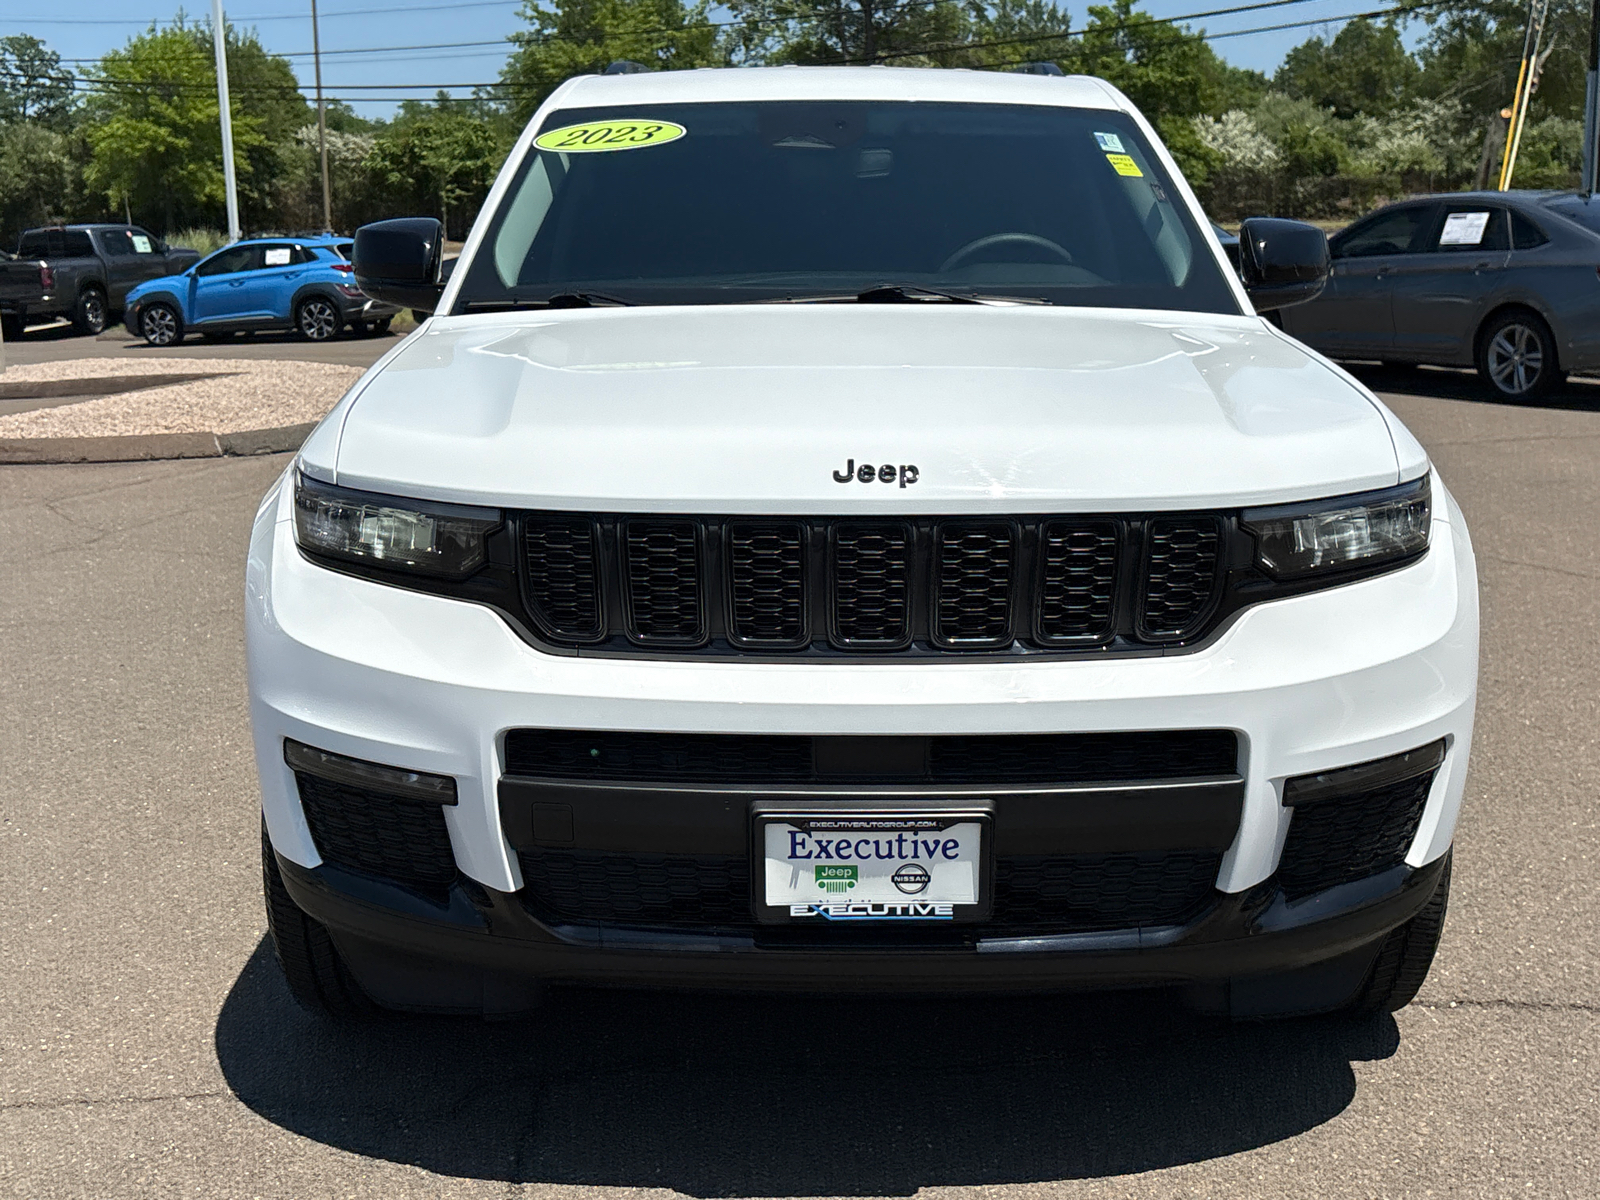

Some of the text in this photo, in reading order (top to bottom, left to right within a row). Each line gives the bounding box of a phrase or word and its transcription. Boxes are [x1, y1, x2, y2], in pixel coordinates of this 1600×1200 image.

[554, 126, 663, 147] 2023
[833, 459, 920, 489] Jeep
[788, 830, 960, 860] Executive
[821, 866, 852, 879] Jeep
[790, 904, 954, 917] EXECUTIVE
